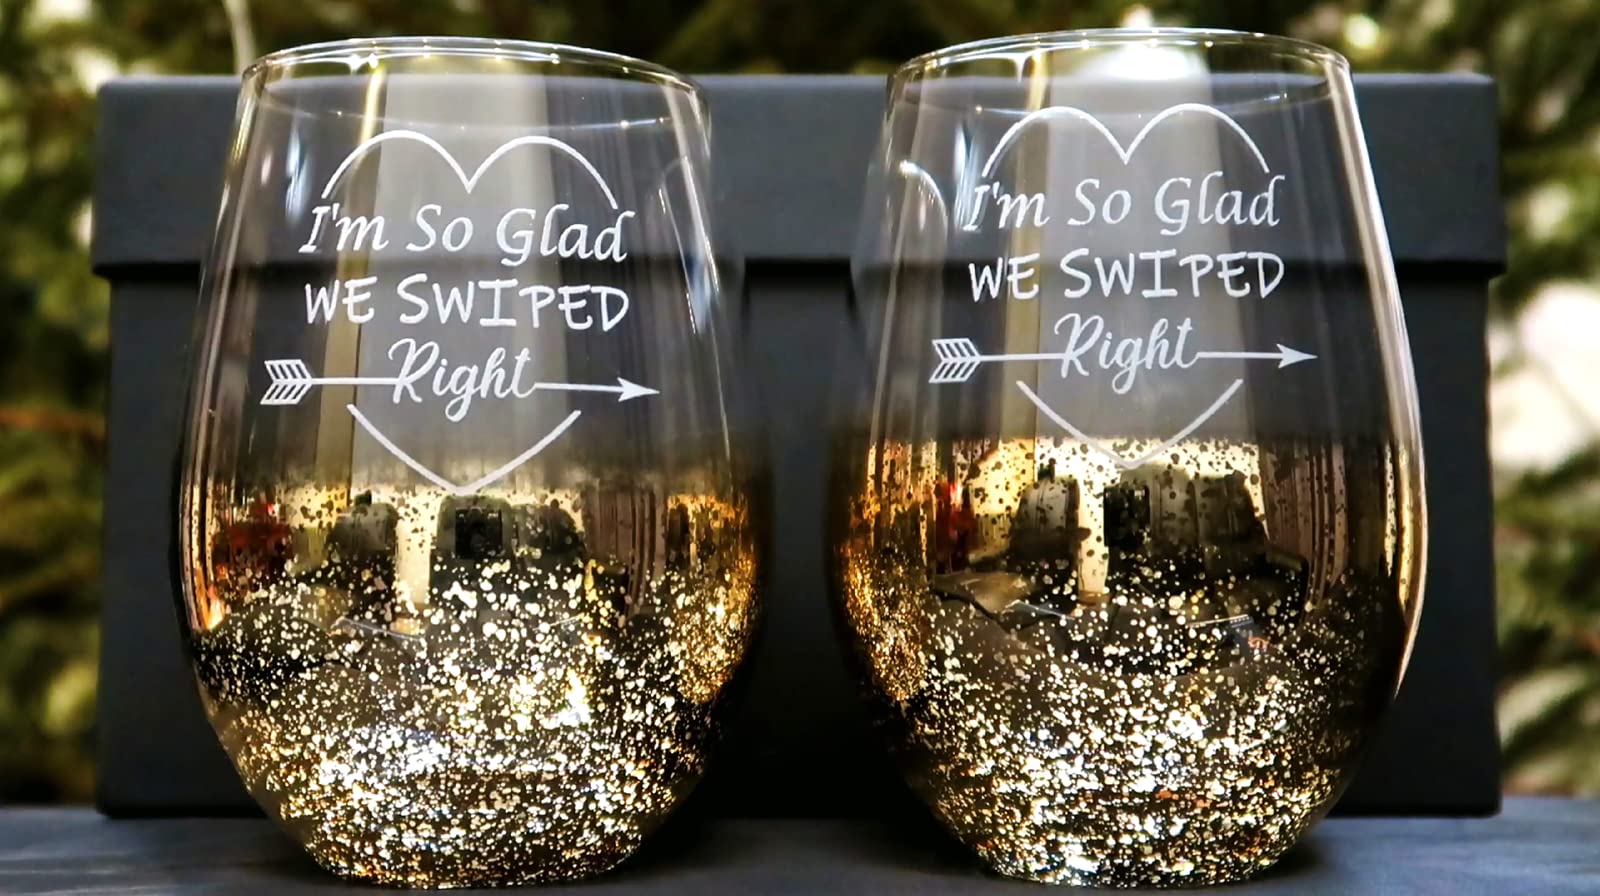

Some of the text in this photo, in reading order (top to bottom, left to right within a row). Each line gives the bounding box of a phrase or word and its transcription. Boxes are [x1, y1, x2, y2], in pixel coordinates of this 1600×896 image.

[299, 203, 635, 266] I'm So Glad
[963, 171, 1285, 236] I'm So Glad
[305, 273, 630, 332] WE SWIPED
[968, 248, 1285, 302] WE SWIPED
[387, 338, 537, 423] Right
[1054, 313, 1199, 395] Right
